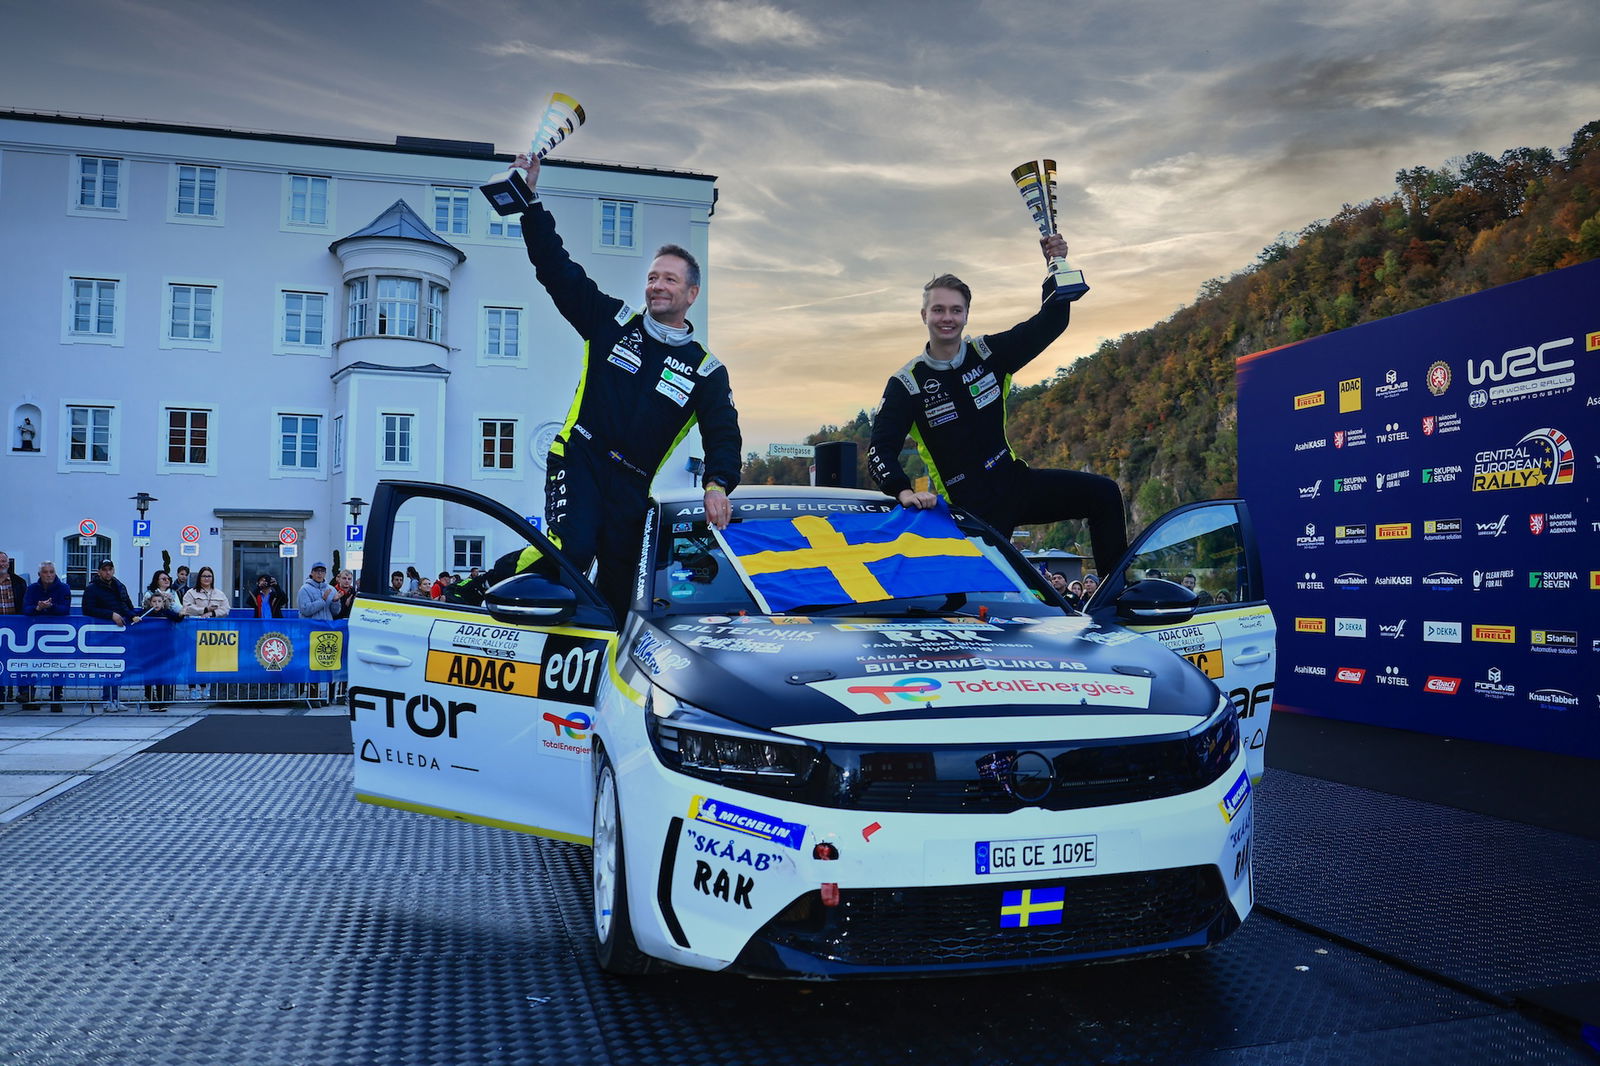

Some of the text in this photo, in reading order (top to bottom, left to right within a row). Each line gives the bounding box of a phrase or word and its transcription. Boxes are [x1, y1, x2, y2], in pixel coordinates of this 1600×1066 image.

[663, 356, 693, 375] ADAC
[1468, 337, 1575, 385] WRC
[962, 365, 984, 384] ADAC
[1340, 380, 1360, 393] ADAC
[1506, 384, 1538, 393] WORLD
[1540, 377, 1573, 387] RALLY
[1297, 393, 1322, 407] PIRELLI
[1491, 387, 1573, 406] CHAMPIONSHIP
[1376, 431, 1409, 443] TW STEEL
[773, 445, 811, 455] Schrottgasse
[1475, 447, 1530, 463] CENTRAL
[869, 446, 890, 478] OPEL
[1474, 457, 1542, 475] EUROPEAN
[1433, 465, 1462, 475] SKUPINA
[1343, 476, 1367, 485] SKUPINA
[1433, 473, 1456, 483] SEVEN
[1473, 470, 1535, 490] RALLY
[1343, 483, 1362, 492] SEVEN
[557, 470, 567, 522] OPEL
[739, 503, 792, 511] OPEL
[797, 503, 878, 512] ELECTRIC
[1549, 519, 1577, 527] SPORTOVNÍ
[1379, 526, 1408, 537] PIRELLI
[1375, 576, 1413, 585] AsahiKASEI
[1485, 569, 1514, 580] CLEAN FUELS
[1543, 571, 1578, 580] SKUPINA
[1485, 579, 1503, 588] FOR ALL
[1543, 580, 1570, 588] SEVEN
[1298, 620, 1323, 630] PIRELLI
[1345, 623, 1363, 631] DEKRA
[1436, 627, 1457, 636] DEKRA
[199, 632, 237, 646] ADAC
[456, 624, 520, 642] ADAC OPEL
[669, 624, 820, 642] BILTEKNIK
[878, 630, 992, 642] RAK
[1158, 627, 1203, 642] ADAC OPEL
[1475, 627, 1511, 640] PIRELLI
[1546, 634, 1575, 643] Starline
[453, 635, 518, 650] ELECTRIC RALLY CUP
[1531, 645, 1577, 655] Automotive solution
[856, 653, 918, 661] KALMAR
[544, 646, 599, 694] e01
[864, 658, 1088, 673] BILFÖRMEDLING AB
[1187, 653, 1208, 676] AC
[1294, 665, 1327, 676] AsahiKASEI
[447, 655, 516, 692] ADAC
[1376, 675, 1409, 687] TW STEEL
[948, 679, 1135, 697] TotalEnergies
[1529, 692, 1579, 705] KnausTabbert
[542, 739, 593, 755] TotalEnergies
[386, 748, 441, 771] ELEDA
[718, 810, 791, 838] MICHELIN
[992, 841, 1095, 868] GG CE 109E
[693, 859, 755, 910] RAK
